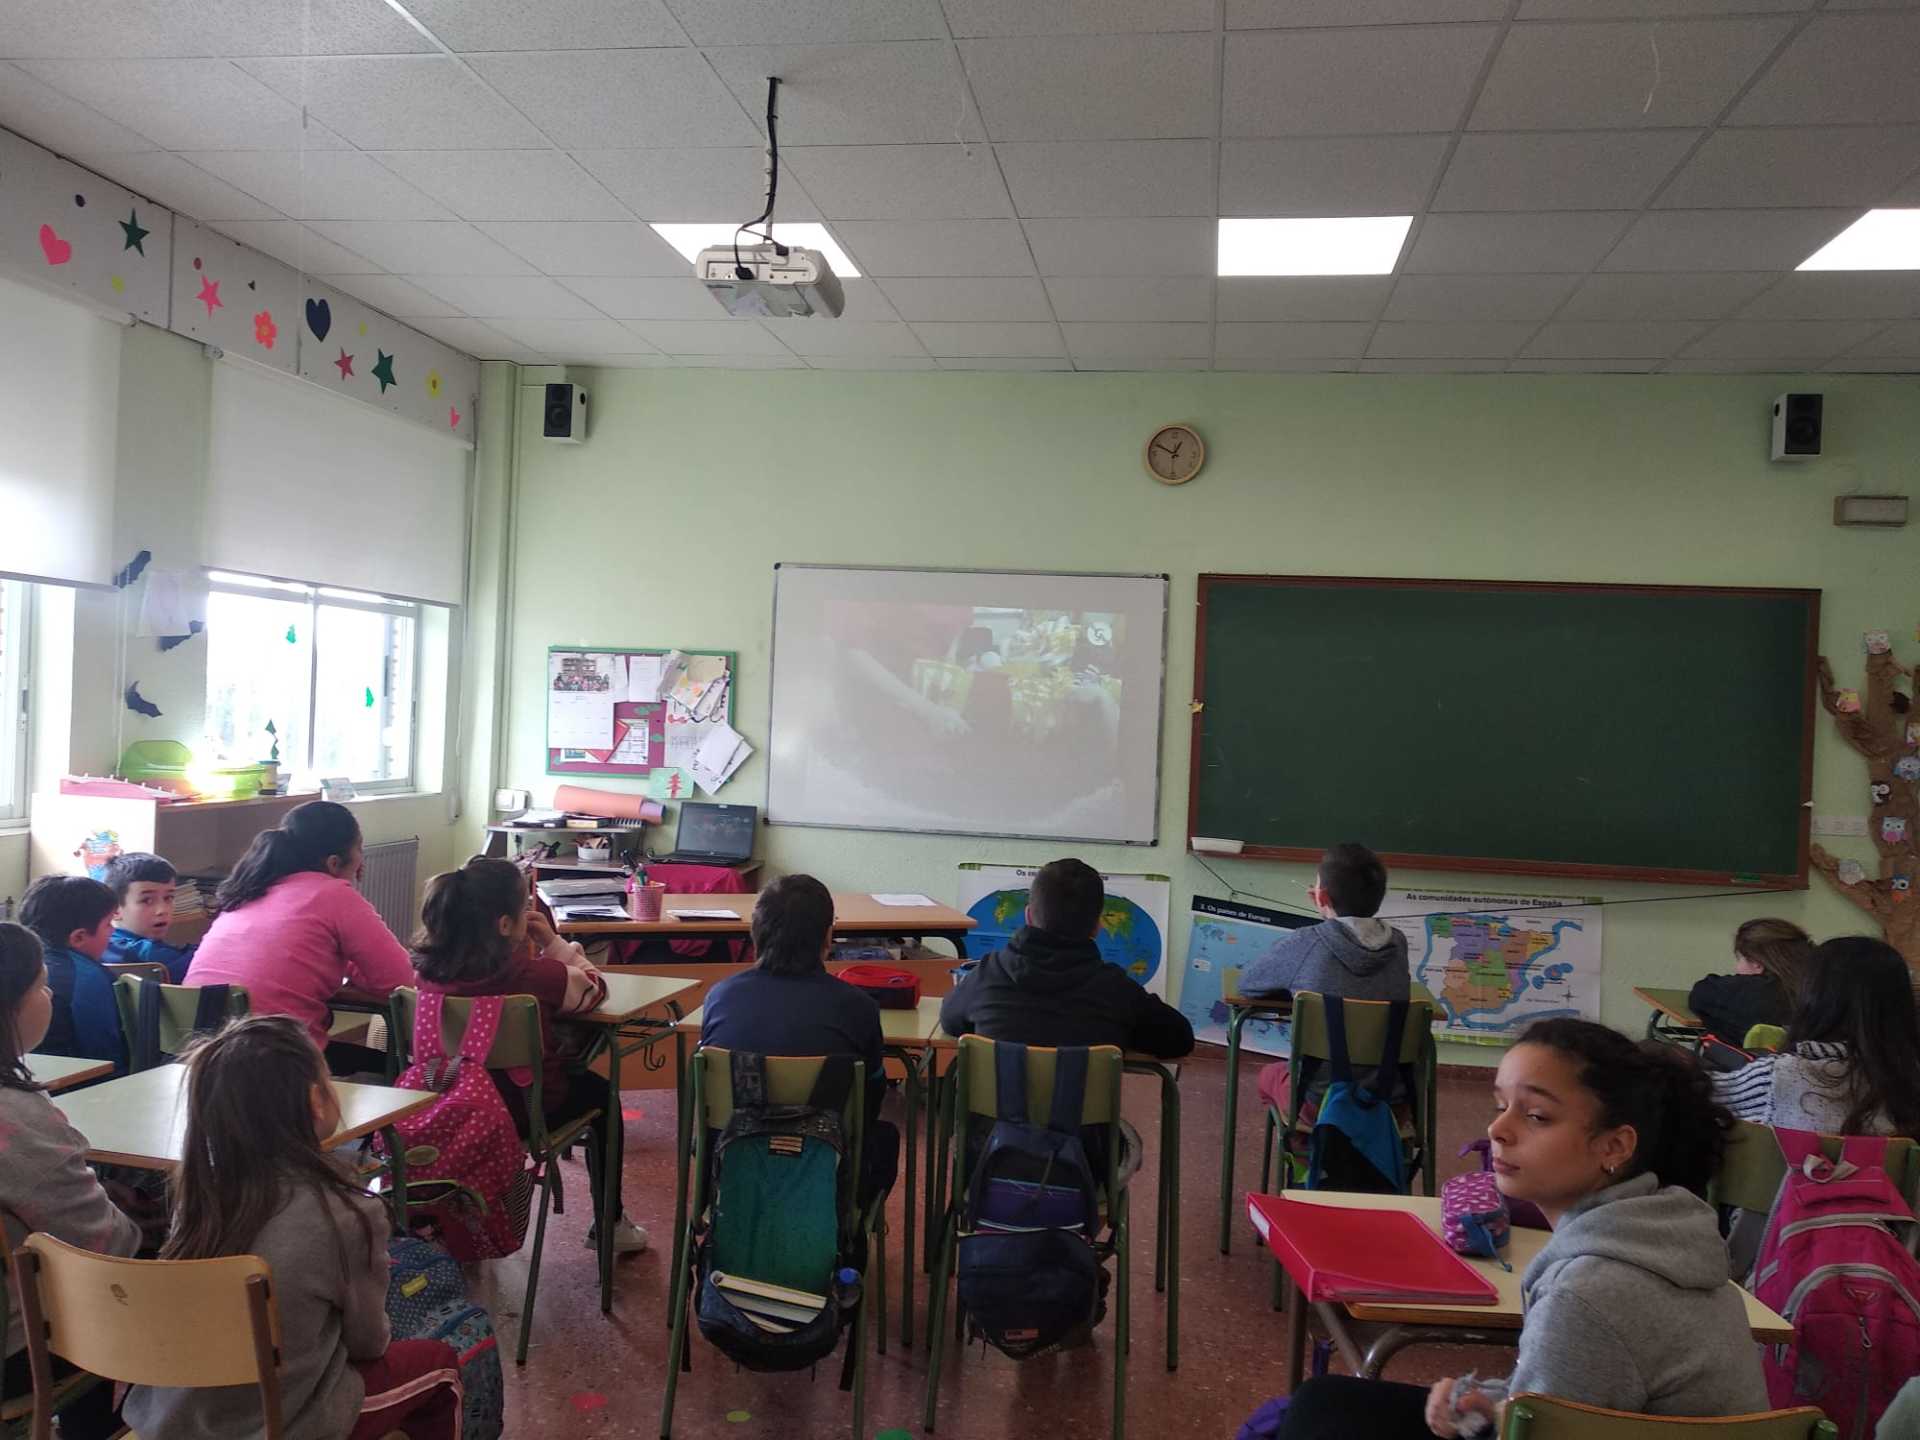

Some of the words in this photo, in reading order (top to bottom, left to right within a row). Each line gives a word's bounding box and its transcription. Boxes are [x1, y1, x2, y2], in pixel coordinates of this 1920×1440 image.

[1406, 893, 1417, 901] As
[1418, 893, 1472, 903] comunidades
[1520, 898, 1531, 906] de
[1532, 898, 1563, 908] España
